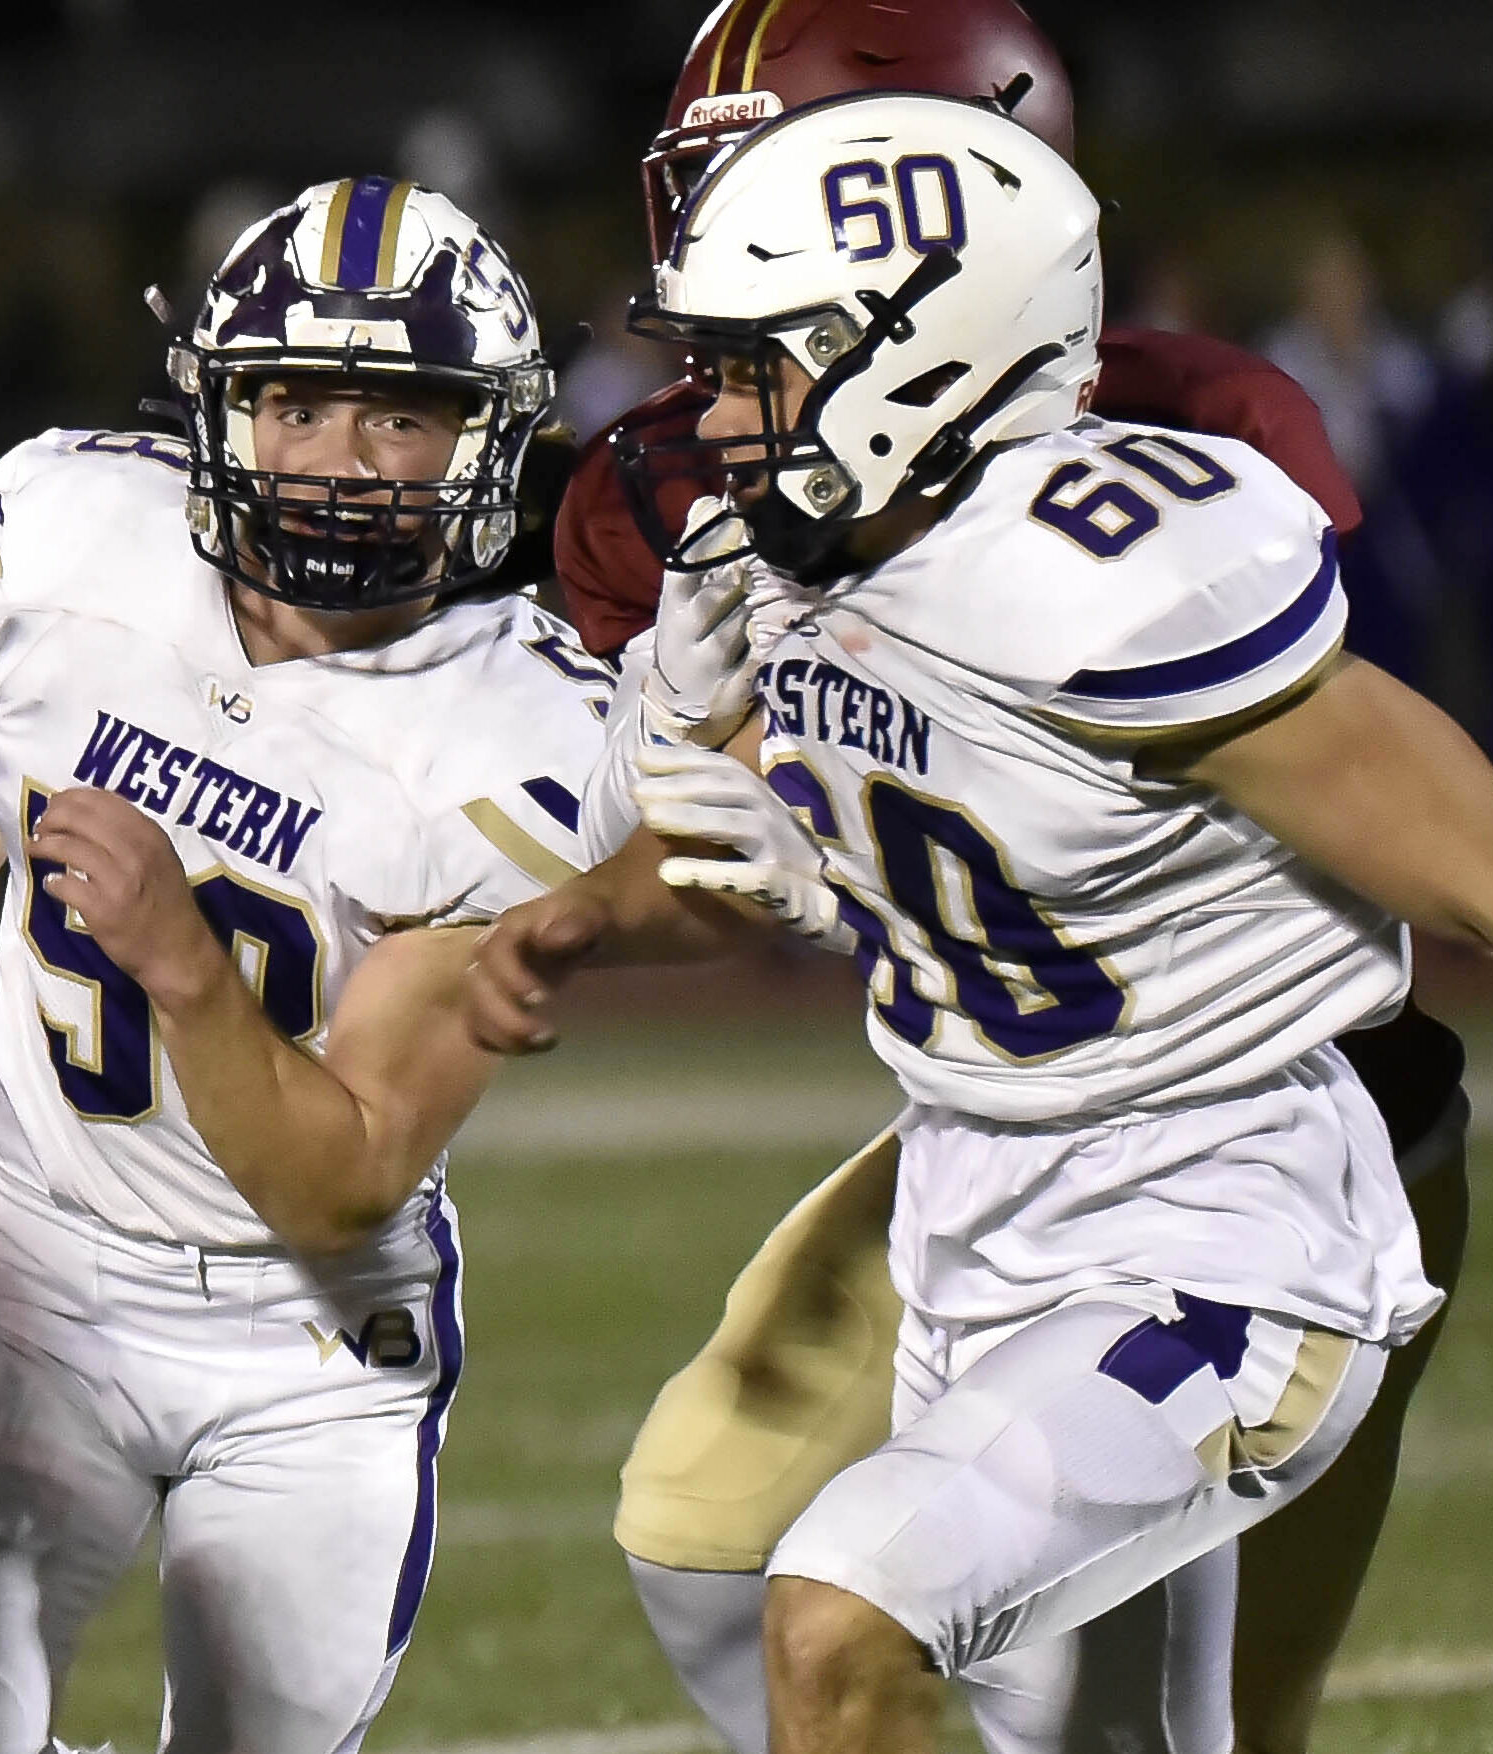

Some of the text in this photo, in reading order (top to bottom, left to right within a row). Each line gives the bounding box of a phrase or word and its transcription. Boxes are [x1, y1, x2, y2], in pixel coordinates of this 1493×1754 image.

[820, 153, 969, 263] 60
[1026, 432, 1243, 562] 60
[72, 709, 323, 874] WESTERN
[300, 1306, 422, 1369] WB
